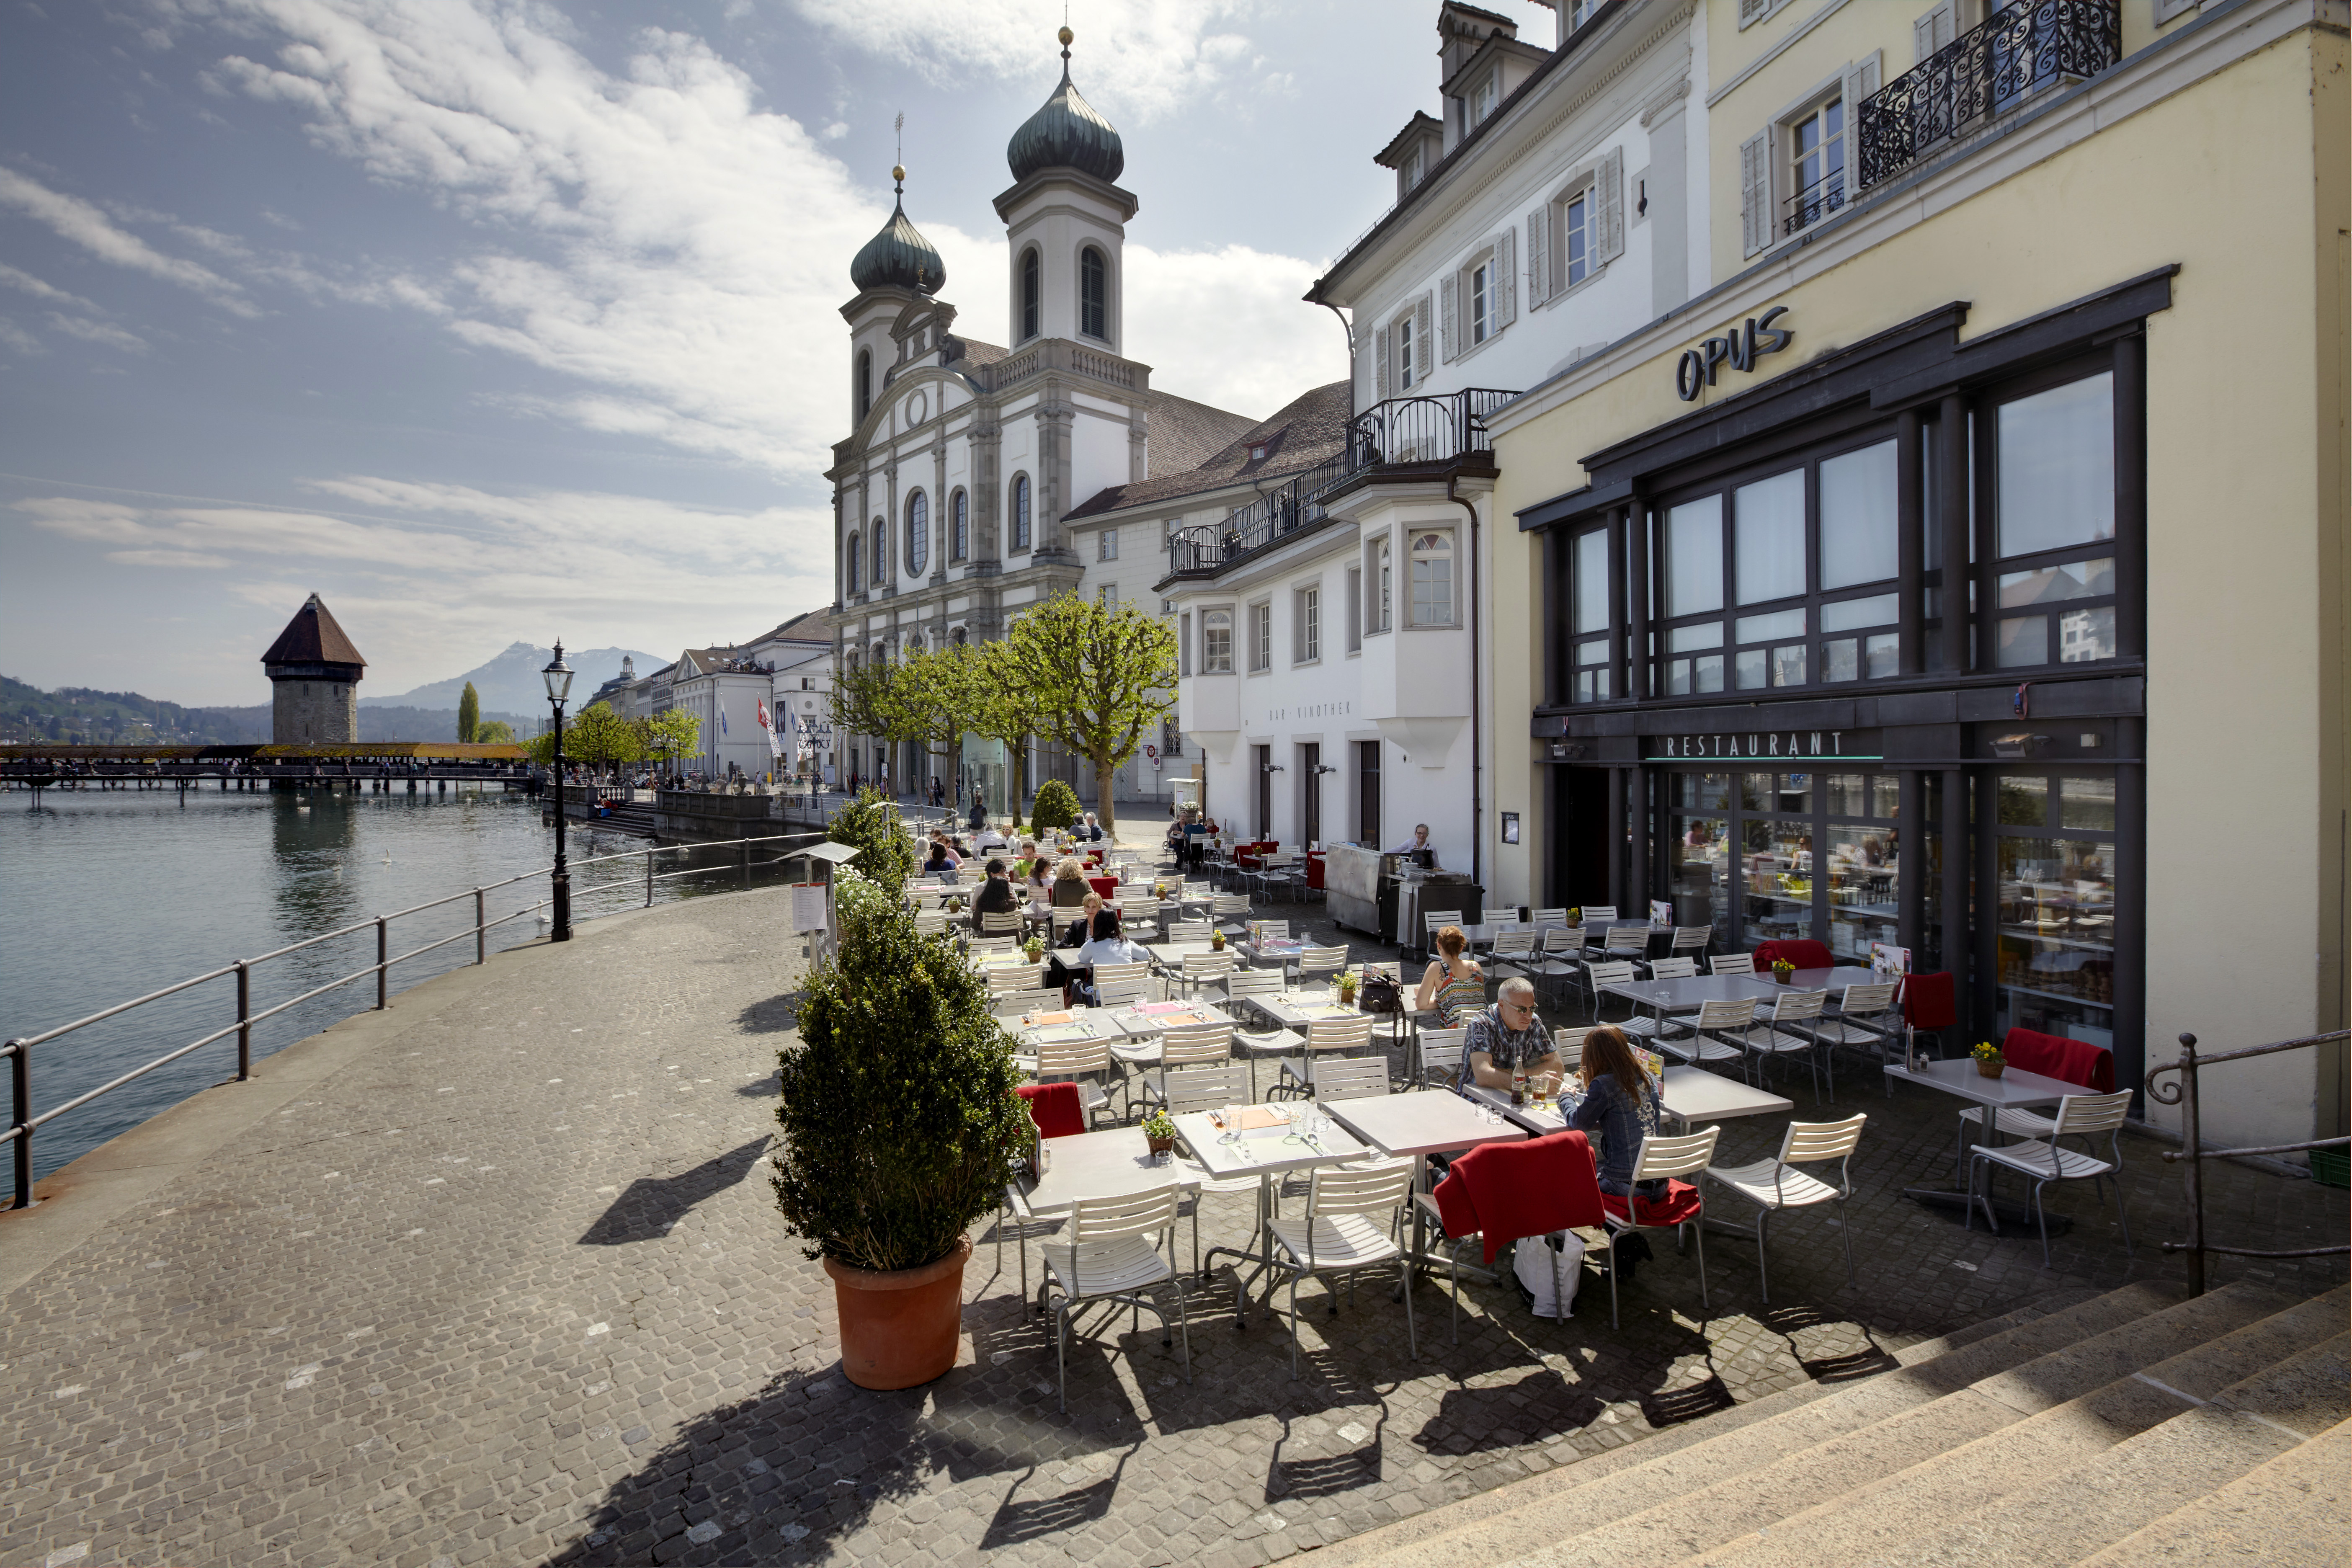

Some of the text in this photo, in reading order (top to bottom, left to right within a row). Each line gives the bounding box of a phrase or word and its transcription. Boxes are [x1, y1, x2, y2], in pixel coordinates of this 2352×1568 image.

[1676, 306, 1792, 402] OPUS
[1269, 701, 1350, 721] BAR VINOTHEK
[1667, 732, 1841, 756] RESTAURANT
